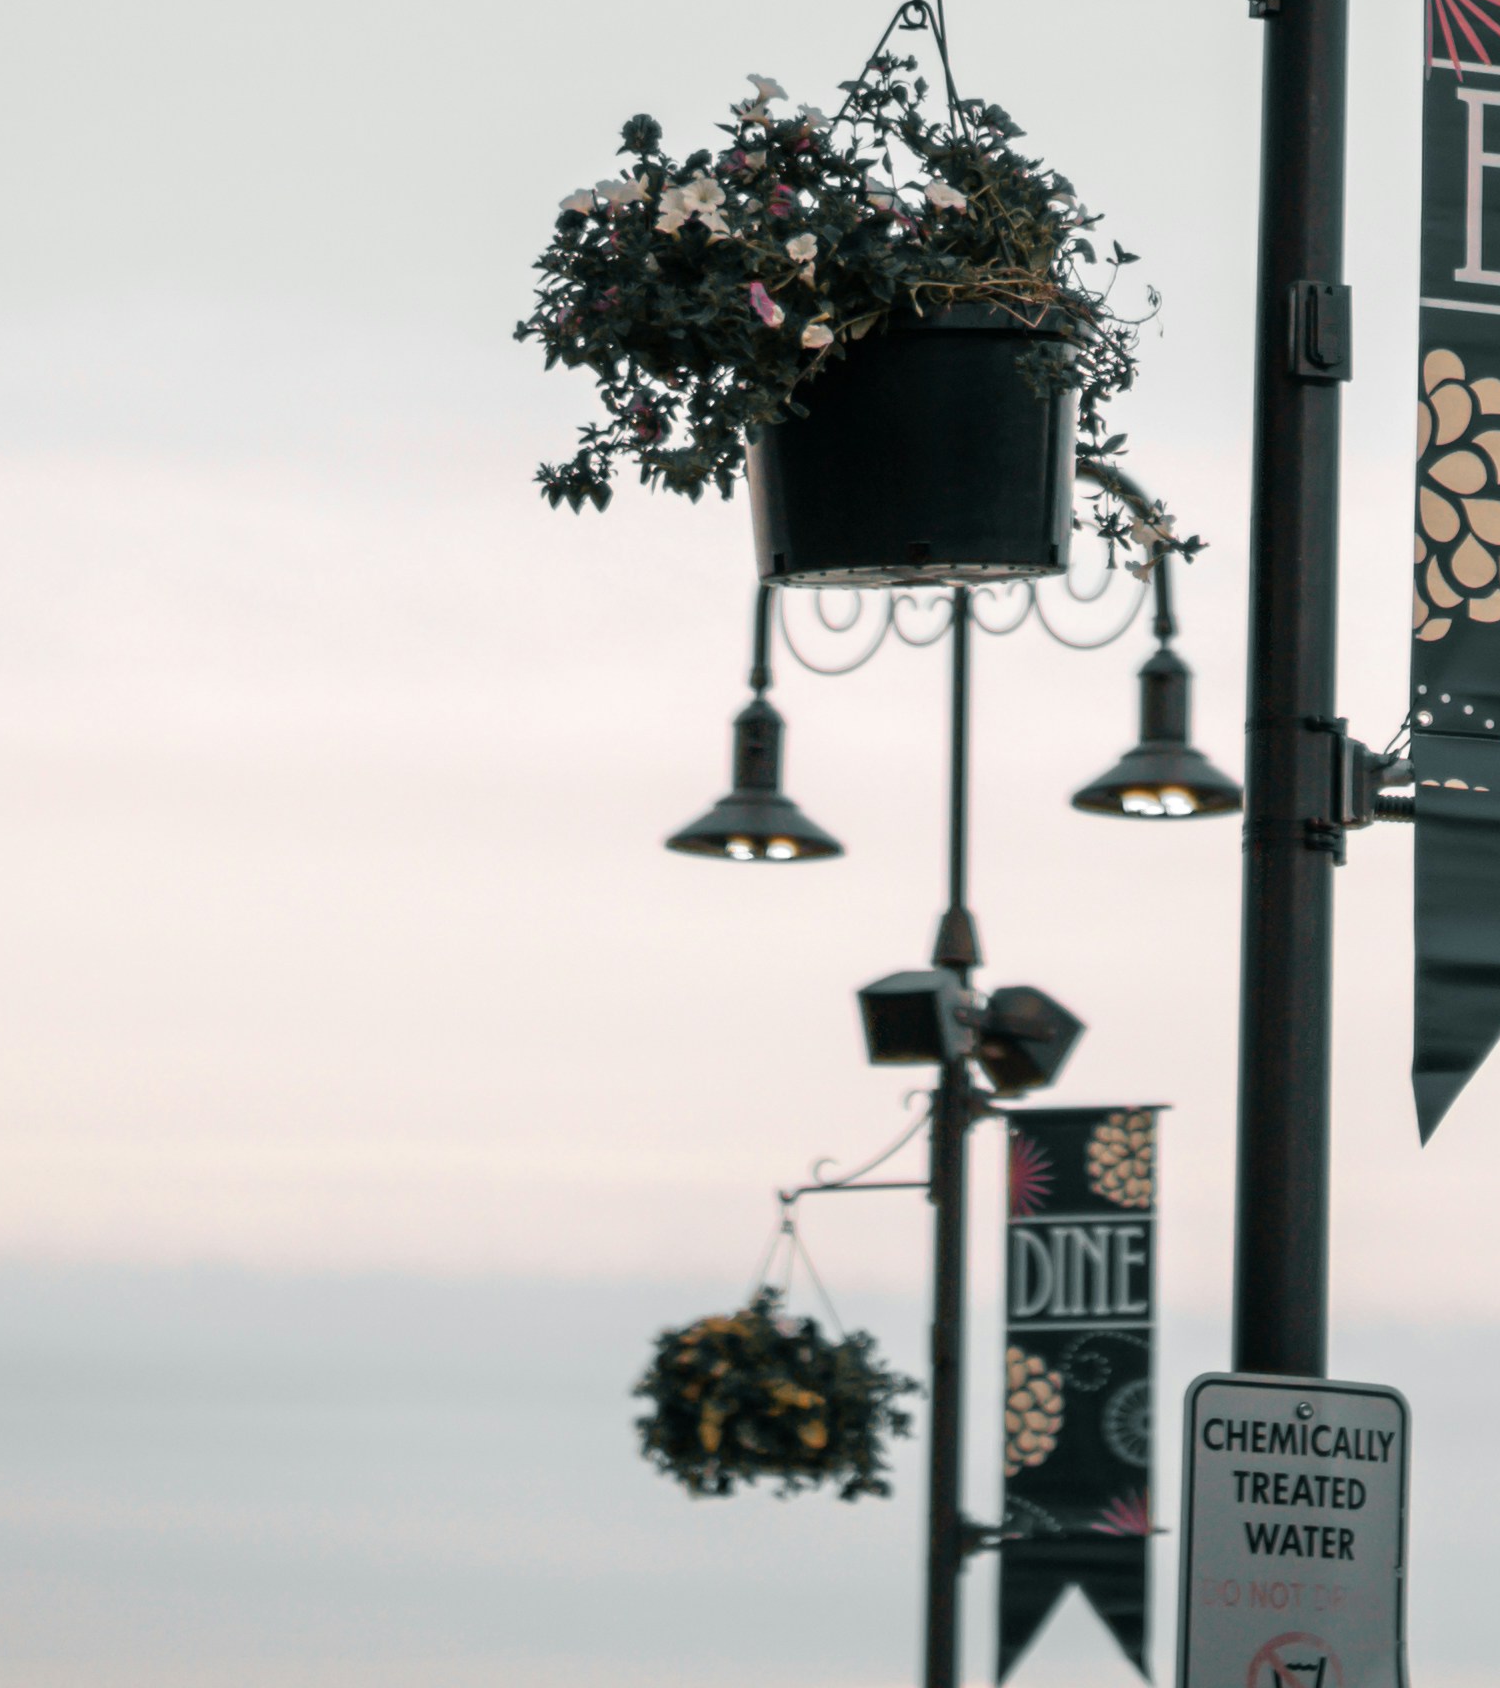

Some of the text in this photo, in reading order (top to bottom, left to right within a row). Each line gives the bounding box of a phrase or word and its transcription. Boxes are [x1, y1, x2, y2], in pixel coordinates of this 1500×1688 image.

[1012, 1226, 1148, 1318] DINE
[1202, 1417, 1396, 1463] CHEMICALLY
[1232, 1470, 1367, 1511] TREATED
[1244, 1521, 1355, 1561] WATER
